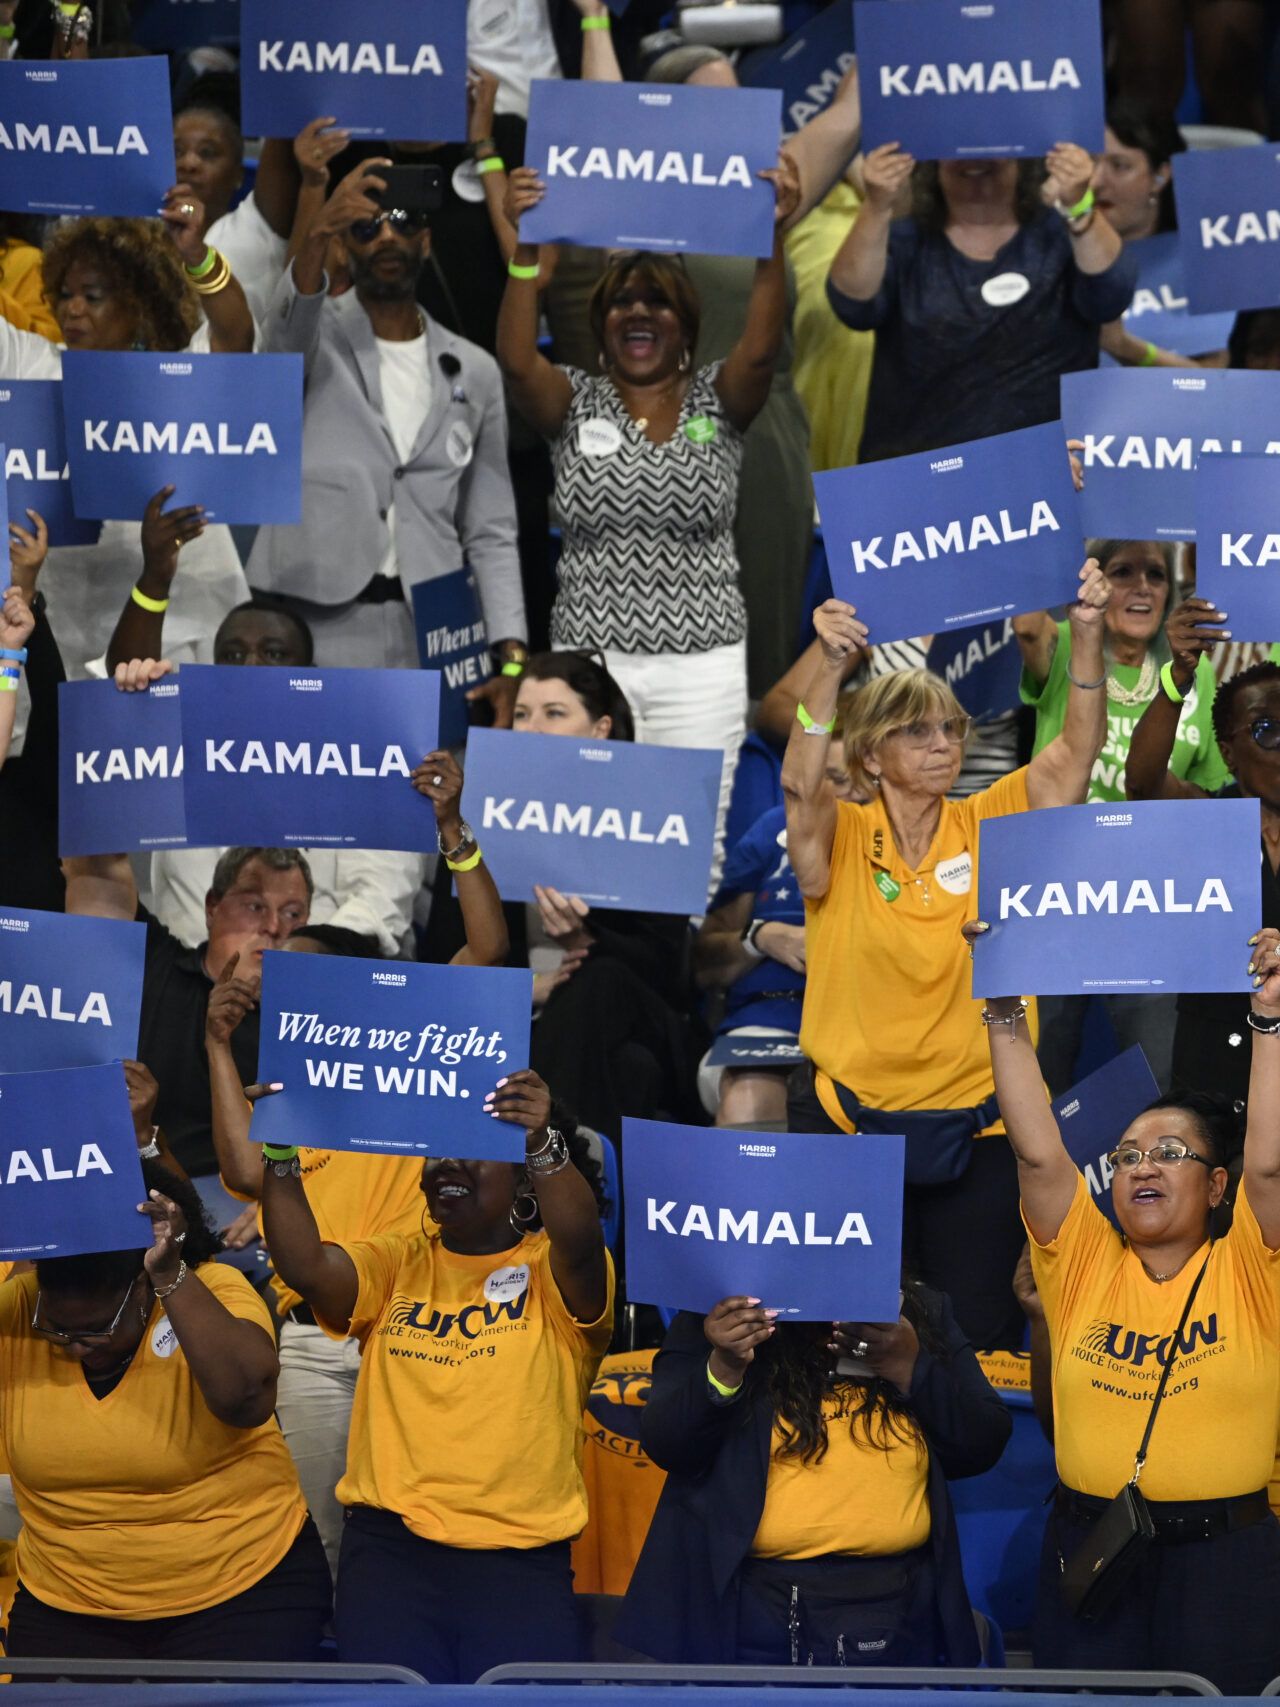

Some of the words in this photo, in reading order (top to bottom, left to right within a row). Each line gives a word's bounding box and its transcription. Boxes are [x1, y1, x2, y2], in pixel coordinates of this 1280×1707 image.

[260, 41, 442, 75] KAMALA
[789, 54, 855, 128] AMA
[881, 58, 1080, 95] KAMALA
[0, 122, 148, 154] AMALA
[548, 146, 752, 187] KAMALA
[85, 421, 277, 454] KAMALA
[931, 457, 963, 467] HARRIS
[852, 501, 1059, 573] KAMALA
[426, 626, 471, 658] When
[444, 657, 477, 689] WE
[206, 740, 410, 777] KAMALA
[483, 797, 688, 845] KAMALA
[1096, 814, 1132, 822] HARRIS
[941, 863, 970, 879] HARRI
[1000, 879, 1232, 919] KAMALA
[373, 973, 406, 981] HARRIS
[279, 1012, 360, 1048] When
[368, 1029, 411, 1052] we
[409, 1024, 507, 1065] fight,
[306, 1059, 364, 1090] WE
[375, 1066, 470, 1099] WIN.
[7, 1144, 113, 1184] ALA
[740, 1145, 776, 1153] HARRIS
[648, 1198, 872, 1245] KAMALA
[490, 1272, 526, 1288] HRIS
[156, 1328, 174, 1348] HAR
[407, 1328, 428, 1341] for
[1104, 1313, 1218, 1366] UFCW
[1107, 1358, 1125, 1374] for
[1177, 1344, 1226, 1372] America
[593, 1429, 642, 1456] ACTI
